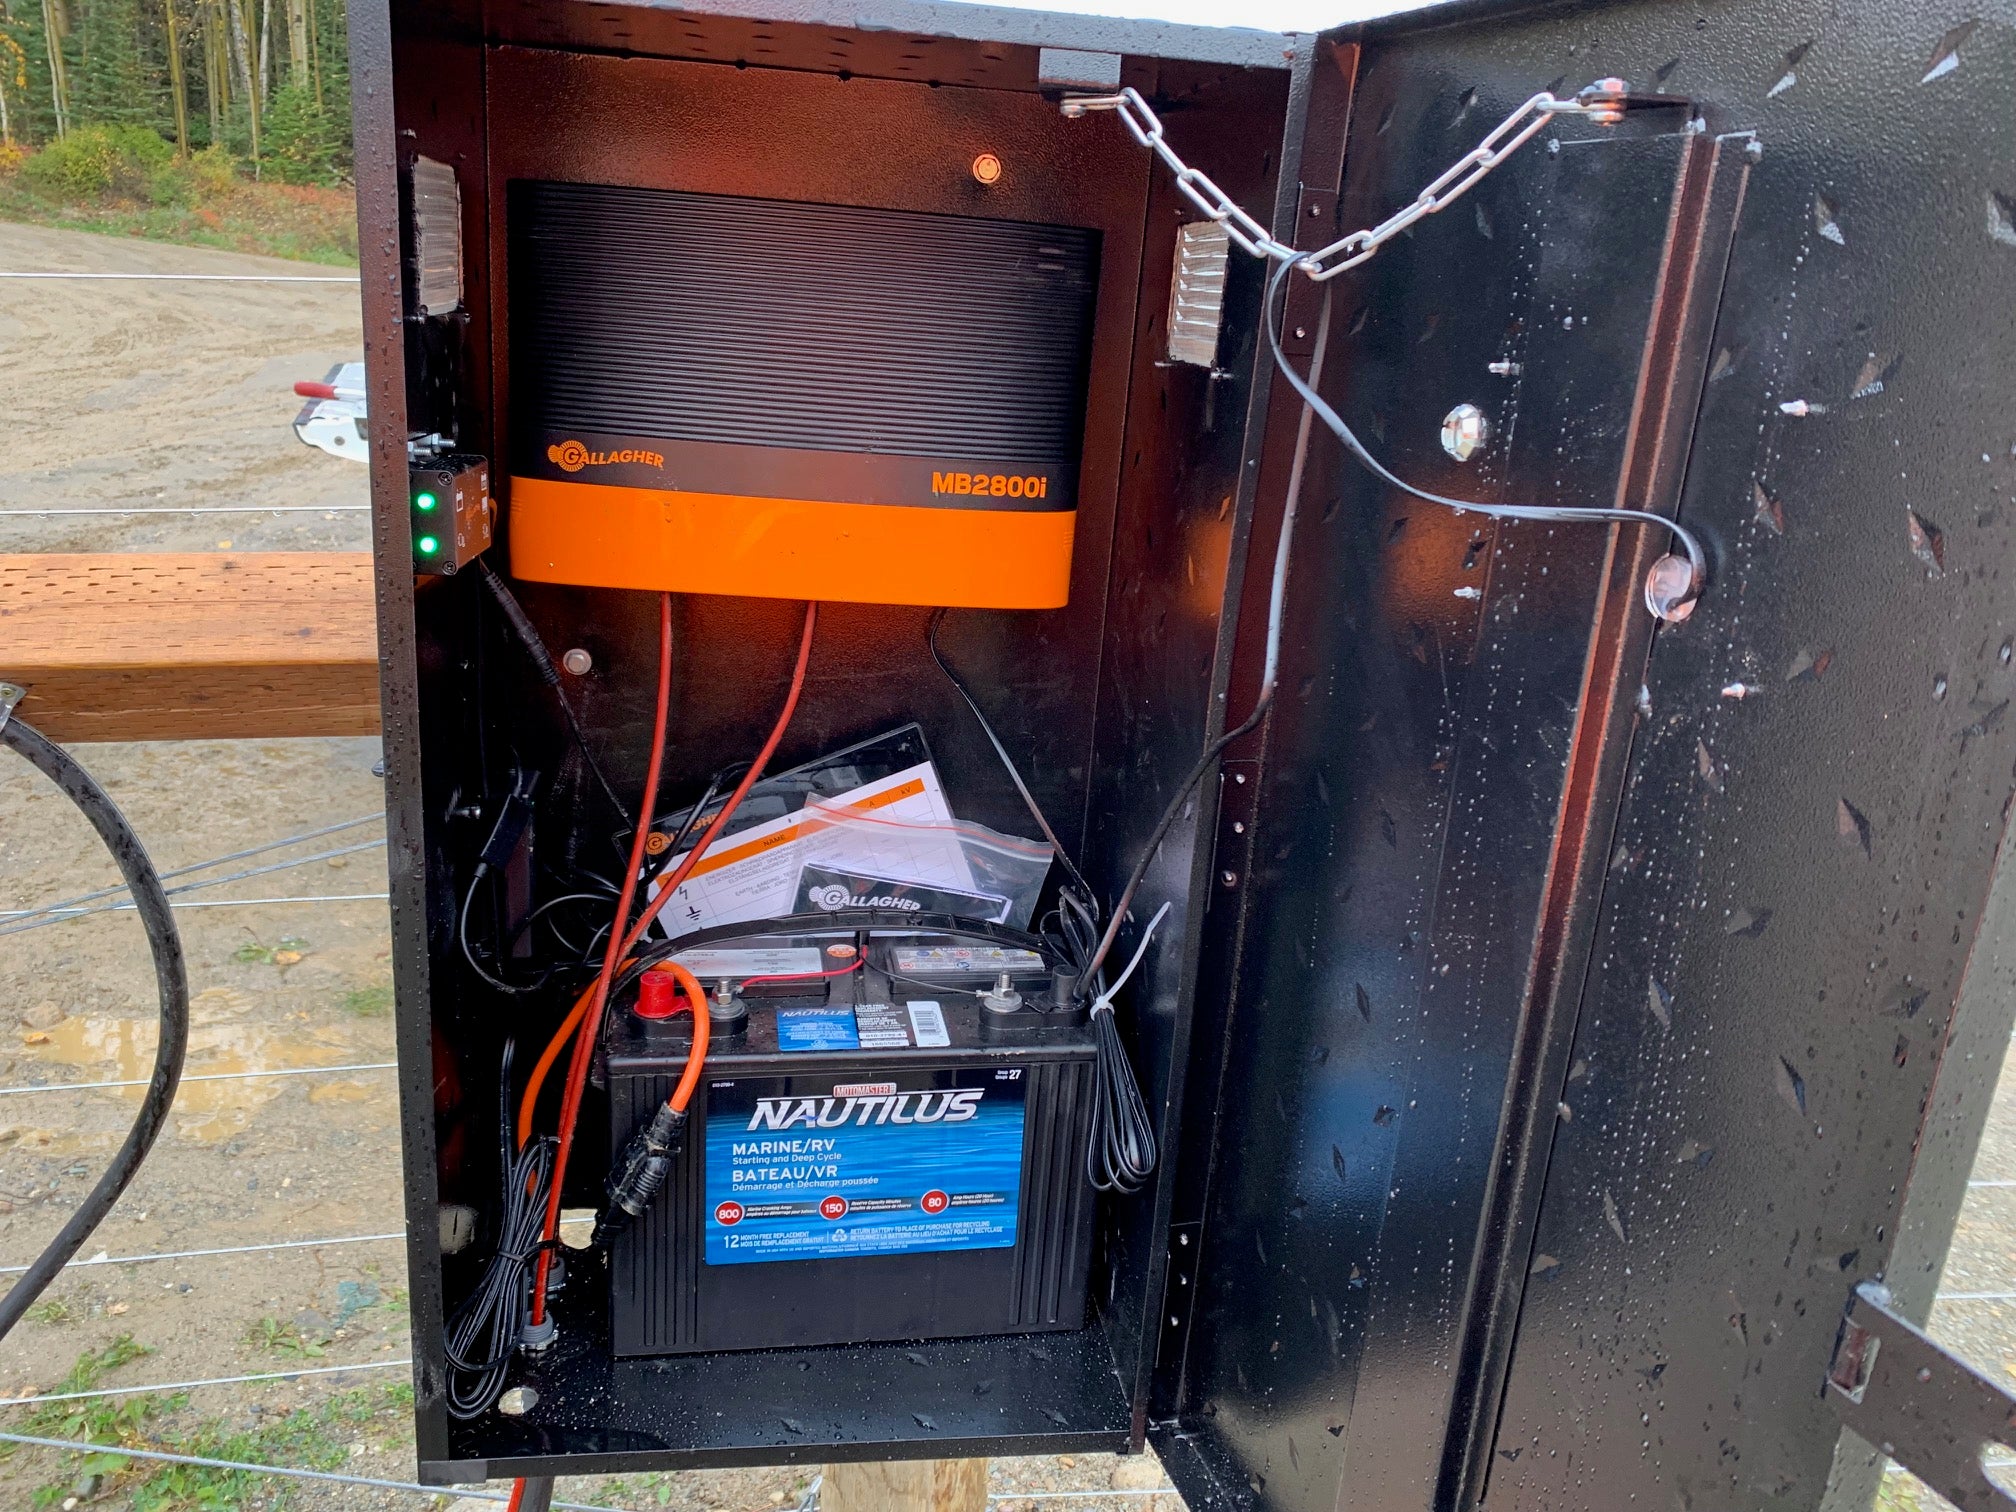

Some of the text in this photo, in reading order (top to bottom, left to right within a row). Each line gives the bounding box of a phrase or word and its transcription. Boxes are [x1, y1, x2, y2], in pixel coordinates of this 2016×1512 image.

[564, 447, 664, 469] GALLAGHER
[932, 471, 1047, 498] MB2800i
[763, 834, 786, 846] NAME
[828, 891, 921, 911] GALLAGHER
[782, 1009, 850, 1018] NAUTILUS
[1009, 1069, 1021, 1080] 27
[836, 1085, 890, 1097] MOTOMASTER
[746, 1092, 984, 1131] NAUTILUS
[732, 1138, 836, 1155] MARINE/RV
[733, 1152, 842, 1165] Starting and Deep Cycle
[732, 1165, 838, 1182] BATEAU/VR
[732, 1175, 879, 1192] Démarrage et Décharge poussée
[825, 1203, 843, 1213] 150
[928, 1197, 942, 1207] 80
[719, 1208, 739, 1219] 800
[724, 1235, 739, 1248] 12
[773, 1231, 809, 1239] REPLACEMENT
